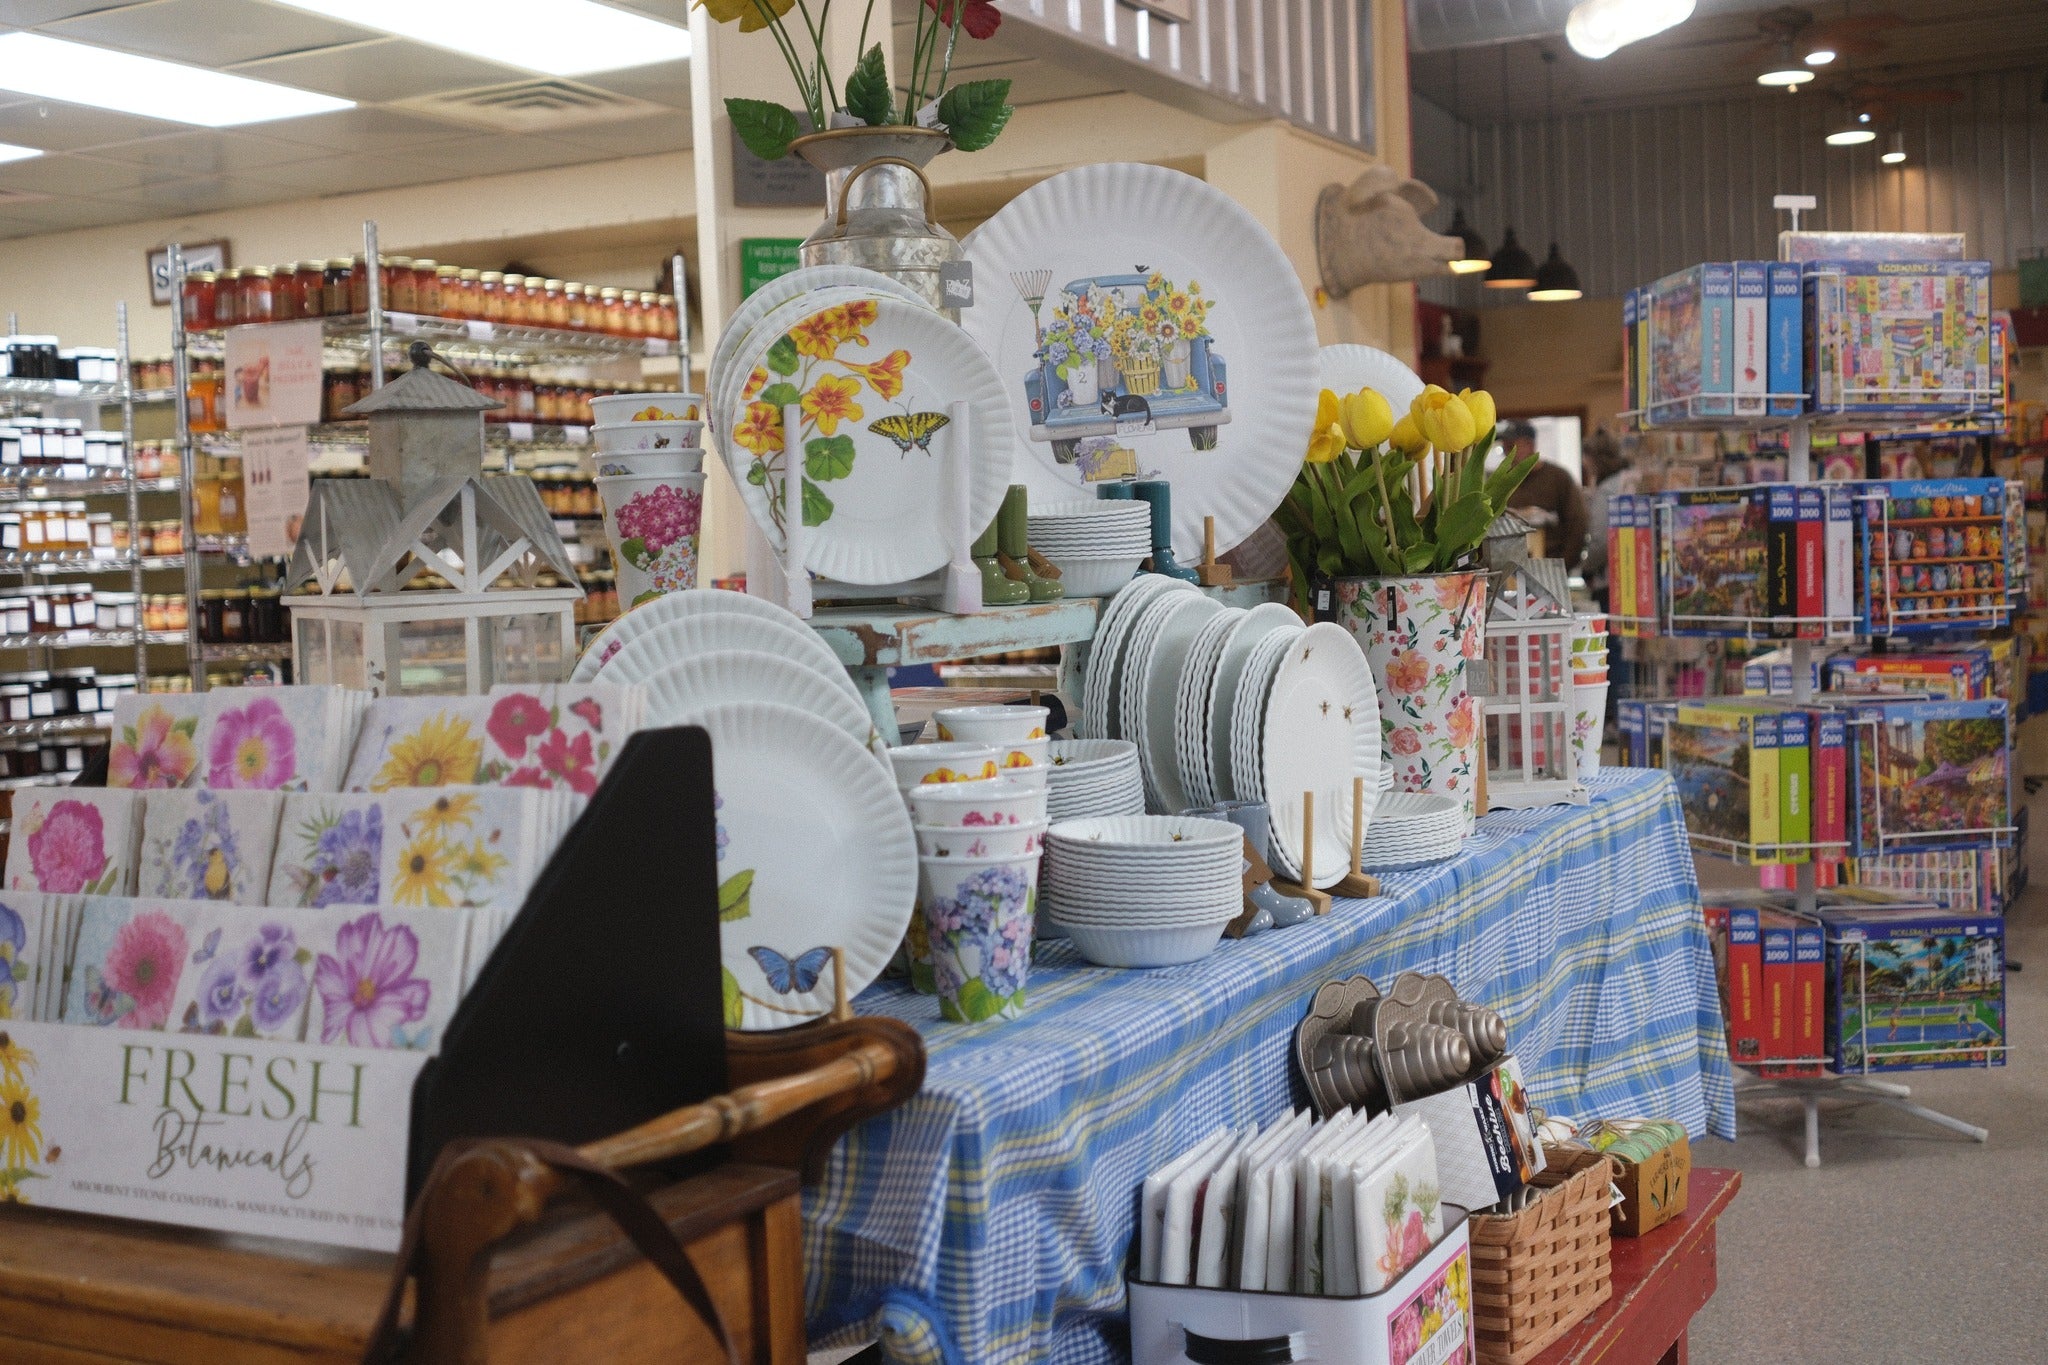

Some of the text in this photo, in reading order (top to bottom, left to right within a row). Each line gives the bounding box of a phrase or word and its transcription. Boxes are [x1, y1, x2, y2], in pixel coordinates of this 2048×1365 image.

[1705, 284, 1730, 294] 1000
[1739, 283, 1763, 294] 1000
[1774, 283, 1798, 294] 1000
[1079, 371, 1088, 384] 2
[1772, 507, 1793, 518] 1000
[1799, 507, 1820, 519] 1000
[1831, 507, 1851, 518] 1000
[1755, 735, 1777, 746] 1000
[1783, 733, 1805, 745] 1000
[1822, 733, 1843, 746] 1000
[1732, 931, 1756, 942] 1000
[1766, 950, 1789, 961] 1000
[1797, 949, 1820, 960] 1000
[117, 1044, 370, 1129] FRESH
[1485, 1093, 1512, 1174] Beehive
[146, 1108, 320, 1199] Botanicals
[71, 1179, 130, 1198] ABSORBENT
[132, 1187, 167, 1201] STONE
